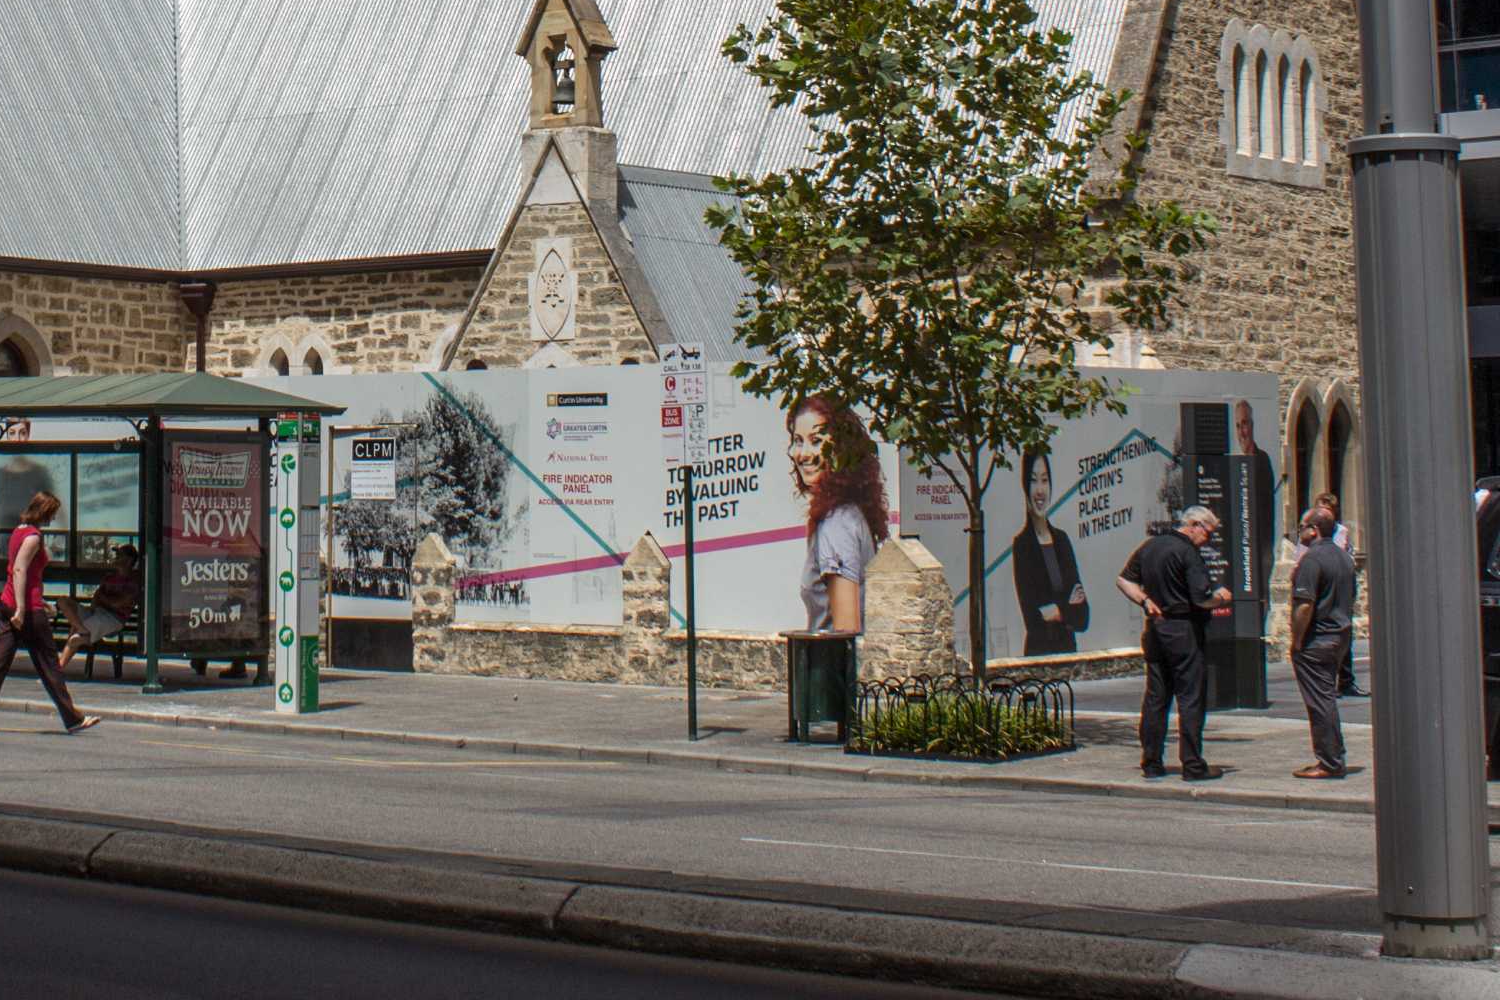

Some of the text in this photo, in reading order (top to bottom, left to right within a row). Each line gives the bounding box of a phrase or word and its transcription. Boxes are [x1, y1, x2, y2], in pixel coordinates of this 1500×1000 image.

[664, 417, 680, 426] ZONE
[665, 409, 678, 417] BUS
[355, 442, 392, 457] CLPM
[1078, 436, 1157, 474] STRENGTHENING
[543, 474, 613, 484] FIRE INDICATOR
[563, 484, 592, 493] PANEL
[666, 475, 759, 506] BY VALUING
[916, 485, 931, 495] FIRE
[1078, 468, 1123, 495] CURTIN'S
[182, 496, 252, 509] AVAILABLE
[931, 495, 952, 504] PANEL
[1078, 494, 1110, 518] PLACE
[182, 509, 252, 537] NOW
[663, 500, 740, 528] TH PAST
[1078, 506, 1133, 539] IN THE CITY
[181, 559, 250, 586] Jesters
[1242, 545, 1252, 592] Brookfield
[188, 607, 227, 629] 50m
